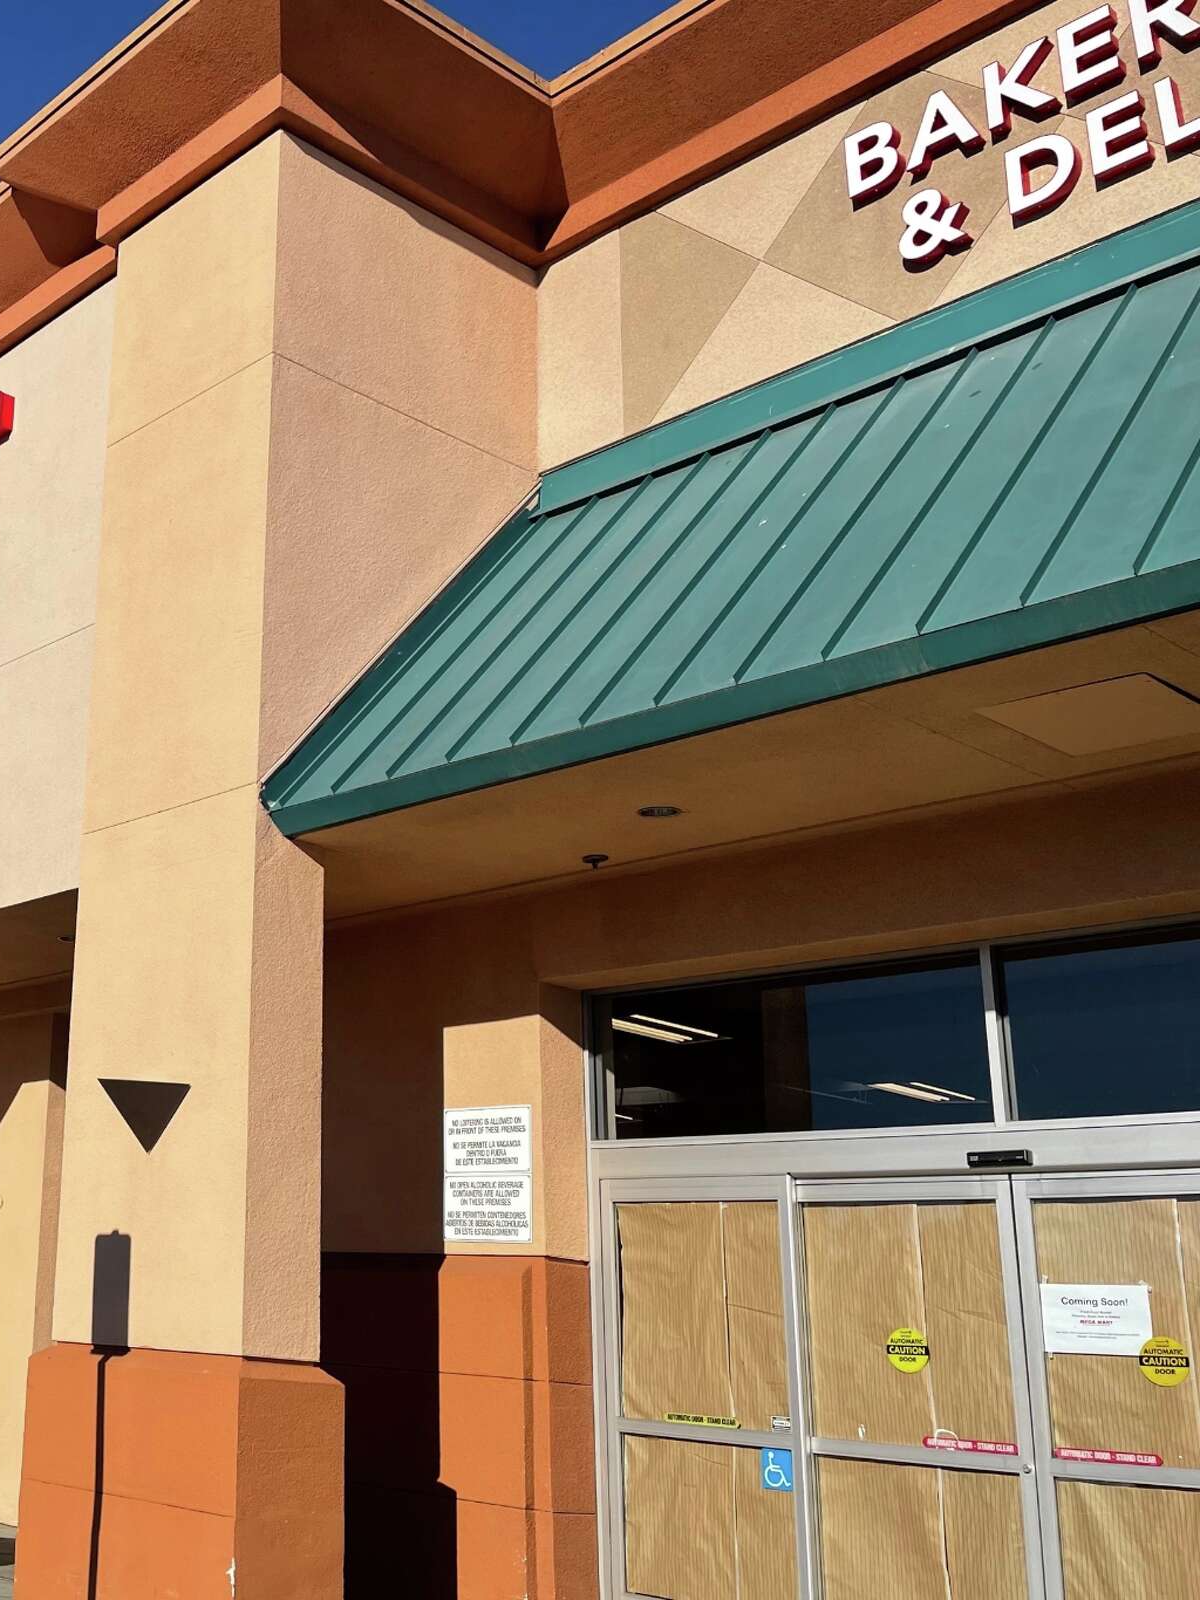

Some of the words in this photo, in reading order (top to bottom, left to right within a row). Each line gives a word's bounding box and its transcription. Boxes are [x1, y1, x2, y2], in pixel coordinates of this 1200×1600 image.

[899, 188, 974, 271] &
[1003, 76, 1200, 225] DEL
[1060, 1296, 1099, 1308] Coming
[1100, 1297, 1129, 1307] Soon!
[888, 1345, 926, 1355] CAUTION
[1143, 1348, 1184, 1356] AUTOMATIC
[1142, 1356, 1187, 1367] CAUTION
[1136, 1454, 1157, 1464] CLEAR
